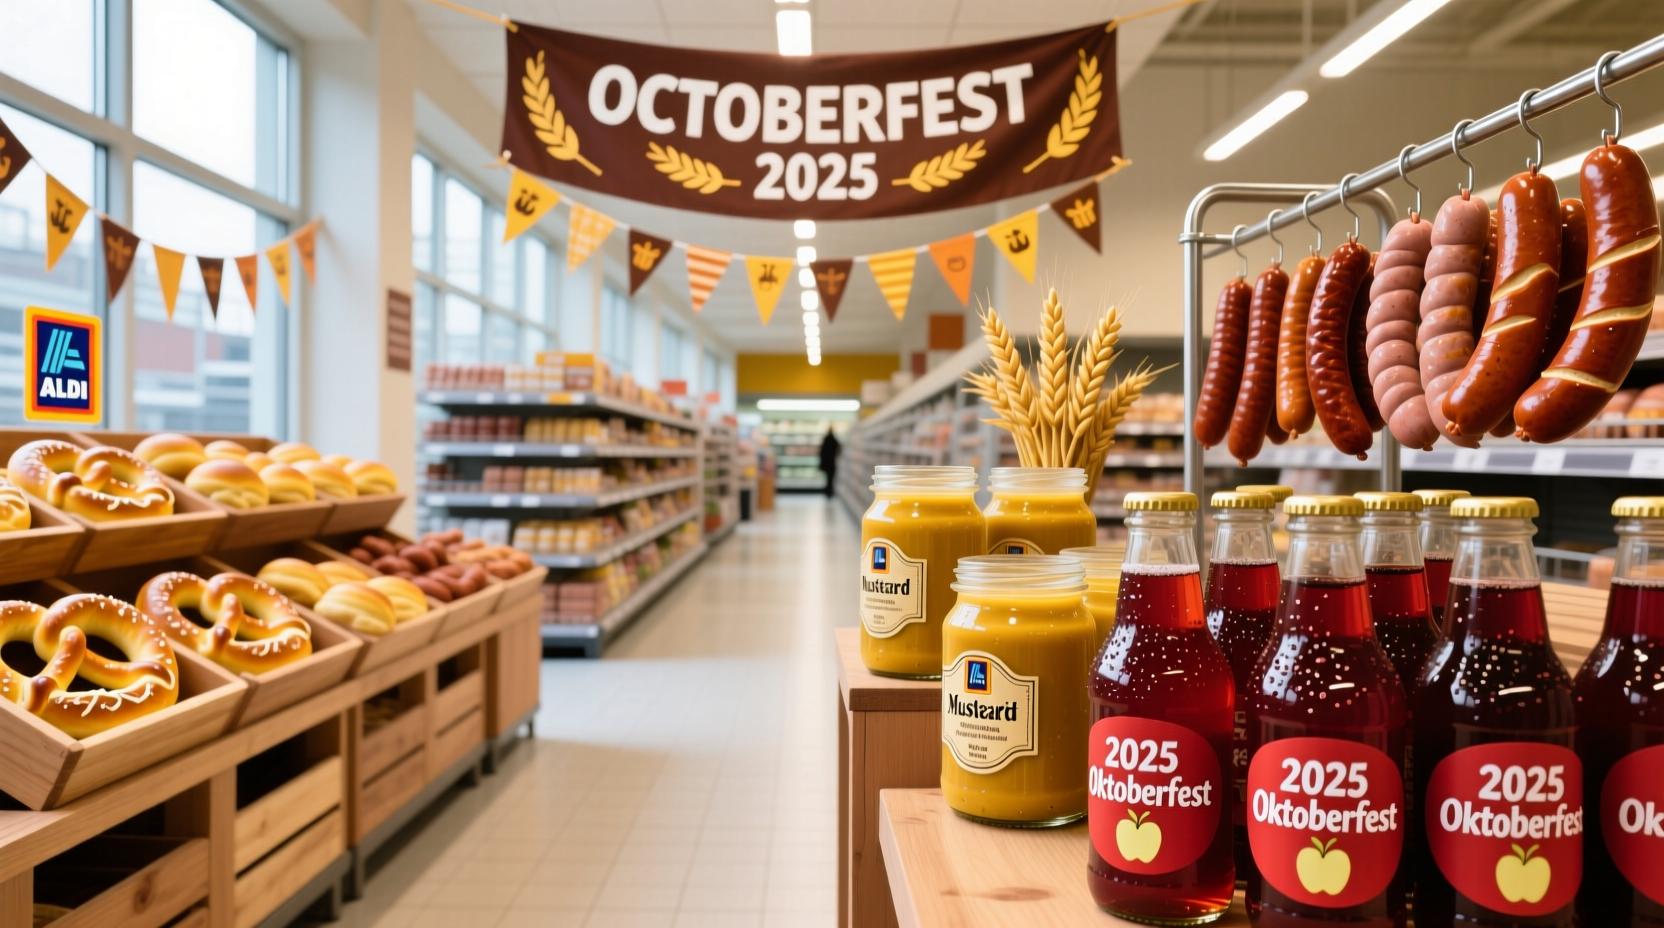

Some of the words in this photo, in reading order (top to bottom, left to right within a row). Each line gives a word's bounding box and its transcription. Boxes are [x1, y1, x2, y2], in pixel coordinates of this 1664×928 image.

[588, 64, 1034, 144] OCTOBERFEST
[753, 152, 879, 201] 2025
[39, 376, 88, 400] ALDI
[1105, 736, 1179, 774] 2025
[1089, 765, 1212, 807] Oktoberfest
[1280, 758, 1368, 798] 2025
[1478, 764, 1565, 802] 2025
[1252, 789, 1398, 833] Oktoberfest
